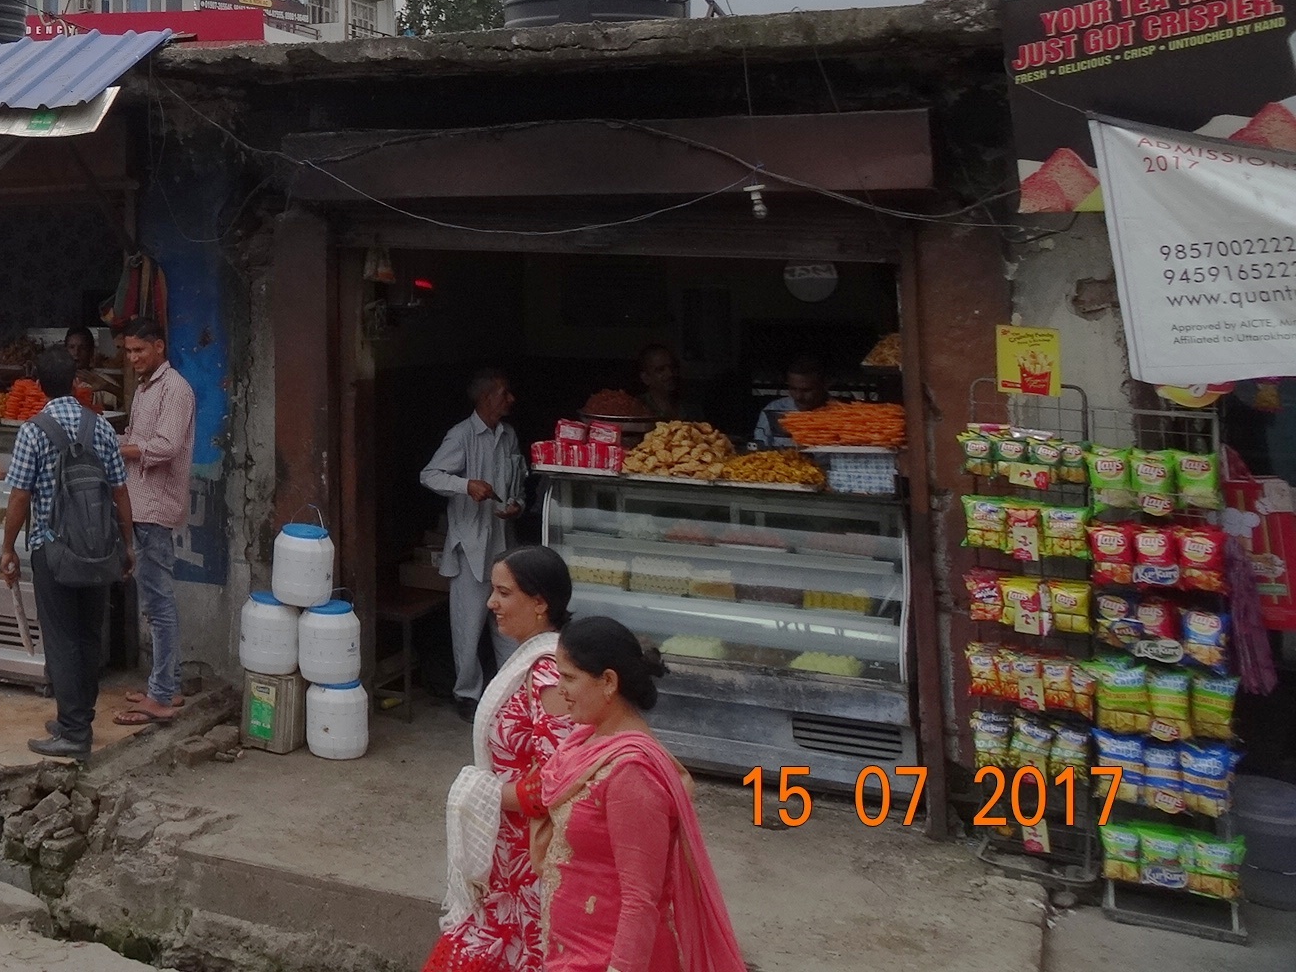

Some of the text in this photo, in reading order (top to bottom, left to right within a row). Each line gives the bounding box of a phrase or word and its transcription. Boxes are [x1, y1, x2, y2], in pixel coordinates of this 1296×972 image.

[1011, 34, 1079, 71] JUST
[1084, 20, 1136, 55] GOT
[1014, 17, 1287, 85] FRESH DELICIOUS CRISP UNTOUCHED BY HAND
[1143, 155, 1200, 173] 2017
[1160, 236, 1296, 261] 9857002222
[1166, 285, 1296, 308] www.quant
[1171, 320, 1221, 333] Approved
[1224, 320, 1237, 331] by
[1173, 334, 1220, 345] Affiliated
[1223, 334, 1234, 343] to
